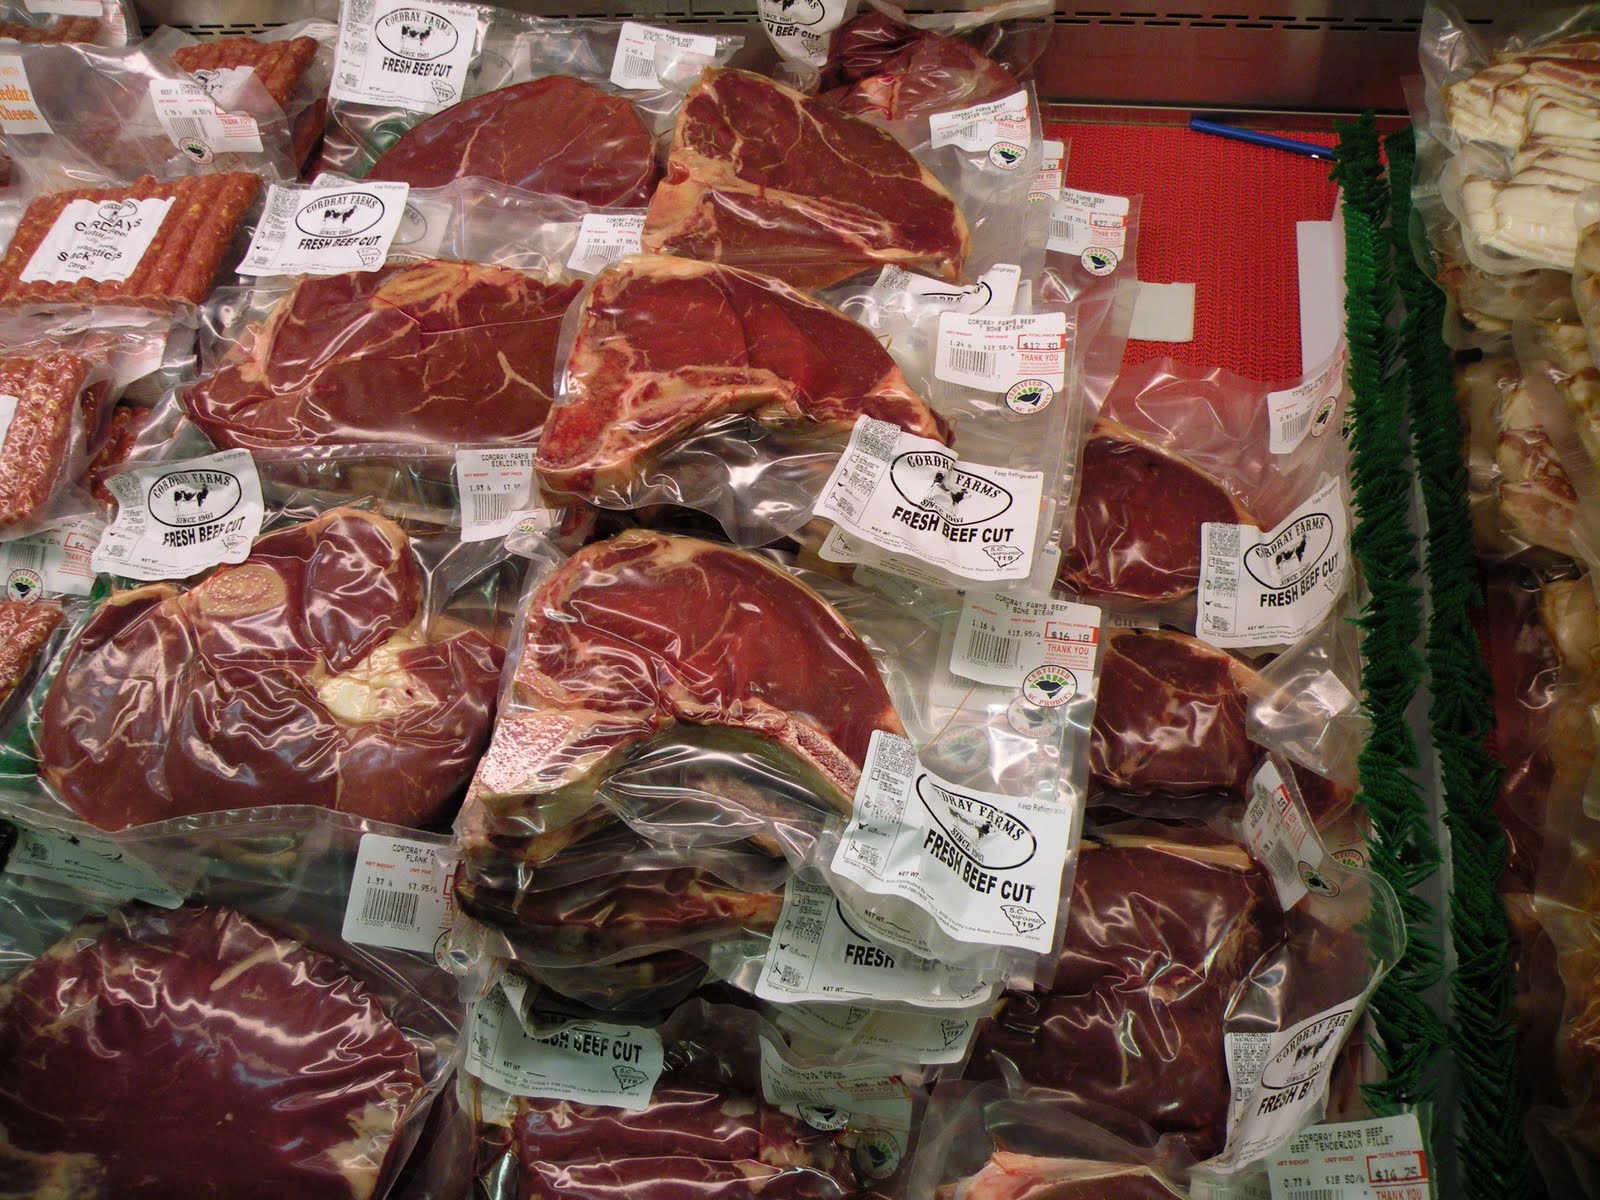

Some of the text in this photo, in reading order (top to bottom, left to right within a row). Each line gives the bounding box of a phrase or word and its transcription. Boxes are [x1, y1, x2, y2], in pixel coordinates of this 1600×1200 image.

[385, 9, 451, 37] CORDRAY FARMS
[775, 25, 822, 42] BEEF CUT
[382, 56, 453, 79] FRESH BEEF CUT
[0, 84, 32, 102] eddar
[997, 121, 1027, 130] THANK YOU
[306, 194, 378, 214] CORDRAY FARMS
[1092, 229, 1109, 237] THANK
[298, 235, 382, 250] FRESH BEEF CUT
[968, 318, 995, 326] CORDRAY
[998, 318, 1017, 326] FARMS
[1004, 324, 1025, 332] STEAK
[1021, 353, 1059, 362] THANK YOU
[1007, 380, 1043, 400] CERTIFIED
[481, 453, 507, 461] CORDRAY
[520, 459, 535, 467] STEA
[906, 453, 1002, 500] CORDR FARMS
[994, 469, 1039, 480] Keep Refrigerated
[153, 472, 232, 499] CORDRAY FARMS
[920, 498, 944, 515] SINCE
[175, 512, 214, 524] SINCE 1907
[891, 505, 1014, 543] FRESH BEEF CUT
[162, 516, 246, 548] FRESH BEEF CUT
[871, 525, 882, 533] NET
[1294, 516, 1326, 537] FARMS
[1260, 552, 1340, 608] FRESH BEEF CUT
[1280, 574, 1299, 587] SINCE
[995, 593, 1068, 611] CORDRAY FARMS BEEF
[1013, 606, 1029, 615] BONE
[972, 619, 987, 629] 1.16
[1048, 643, 1089, 655] THANK YOU
[1026, 664, 1071, 684] CERTIFIED
[1028, 690, 1074, 708] SC PRODUCT
[1018, 801, 1066, 815] Keep Refrigerated
[979, 804, 1025, 842] FARMS
[950, 826, 972, 851] SINCE
[392, 843, 423, 856] CORDRAY
[405, 854, 428, 864] FLANK
[923, 828, 1036, 905] FRESH BEEF CUT
[366, 876, 385, 886] 1.37
[864, 909, 876, 918] NET
[1009, 907, 1024, 916] S.C.
[1015, 919, 1034, 929] 119
[843, 943, 895, 969] FRESH
[1276, 1020, 1325, 1064] CORDRAY
[1325, 1013, 1349, 1031] FAR
[573, 1033, 609, 1057] BEEF
[612, 1040, 643, 1064] CUT
[504, 1060, 512, 1069] NET
[1257, 1085, 1297, 1117] FRESH
[1298, 1126, 1384, 1144] CORDRAY FARMS BEEF
[1290, 1135, 1394, 1154] BEEF TENDERLOIN FILLET
[1288, 1158, 1310, 1166] WEIGHT
[1284, 1177, 1302, 1188] 0.77
[1376, 1188, 1422, 1200] THANK YOU
